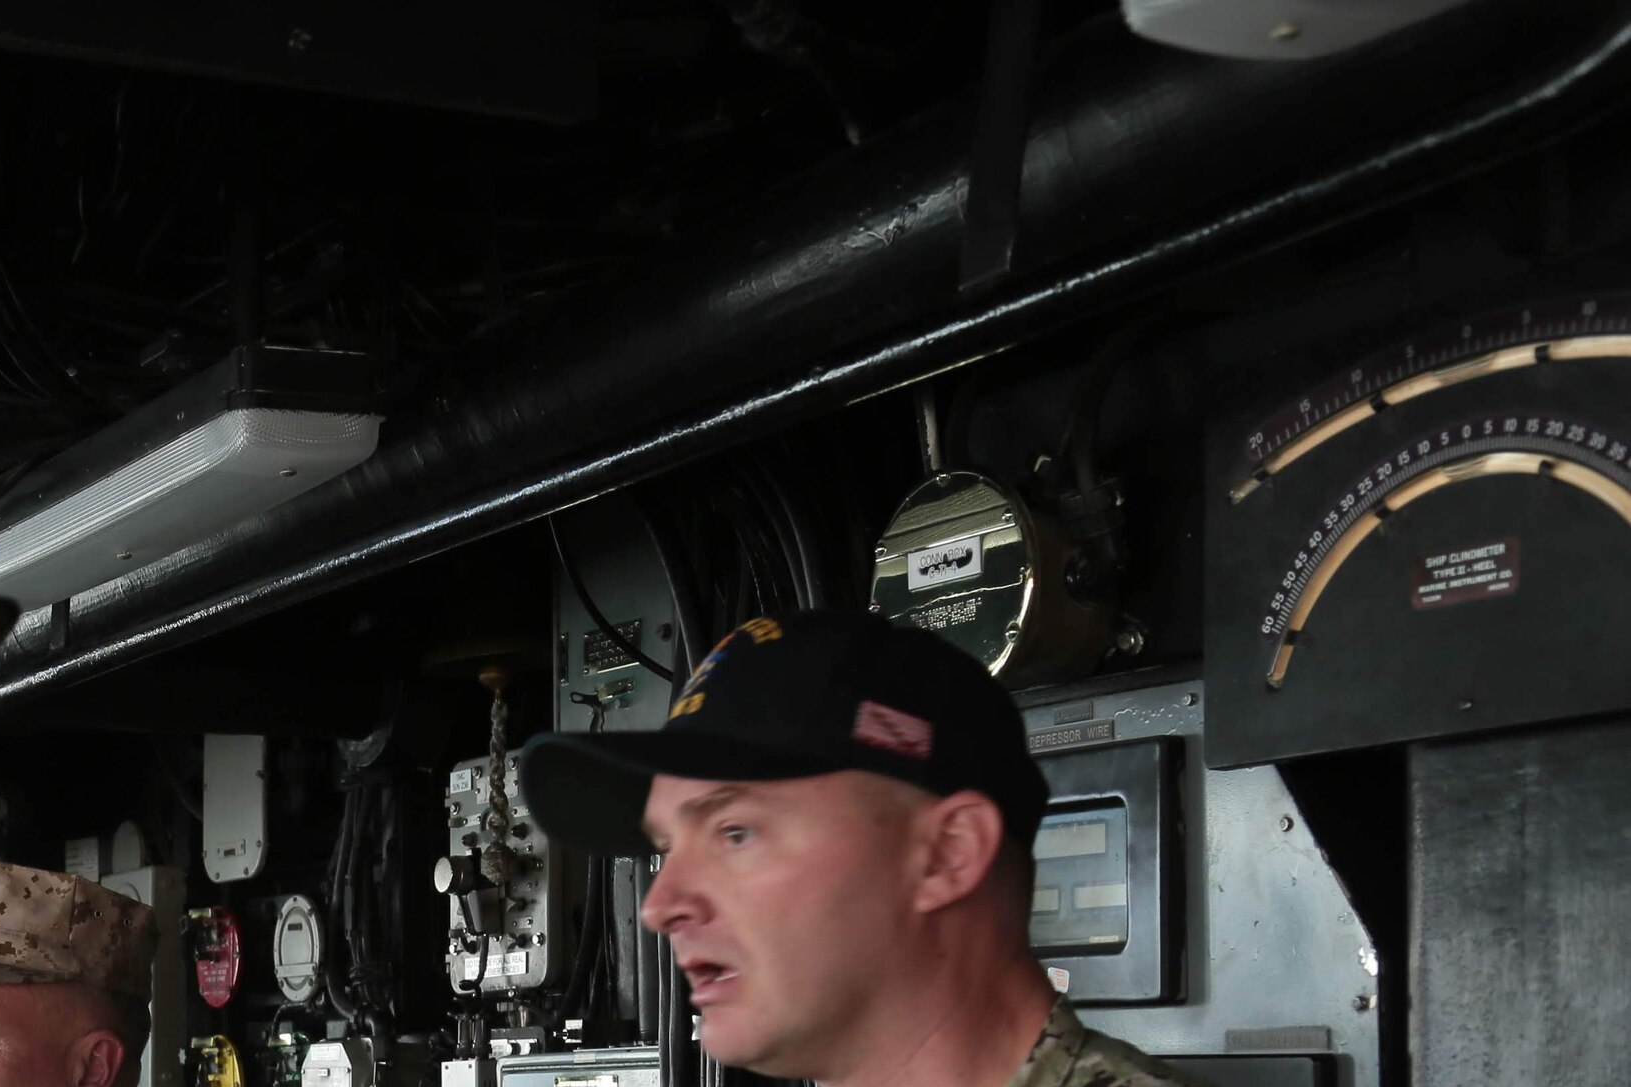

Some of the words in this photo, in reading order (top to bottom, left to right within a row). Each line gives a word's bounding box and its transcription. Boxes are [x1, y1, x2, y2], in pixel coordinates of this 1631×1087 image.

[1249, 432, 1263, 449] 20
[1299, 399, 1310, 413] 15
[1261, 616, 1274, 634] 60
[1271, 592, 1285, 610] 55
[1282, 571, 1296, 589] 50
[1294, 551, 1308, 569] 45
[1308, 531, 1323, 549] 40
[1323, 510, 1339, 529] 35
[1339, 494, 1355, 512] 30
[1357, 476, 1373, 495] 25
[1376, 463, 1392, 480] 20
[1397, 451, 1410, 466] 15
[1417, 440, 1430, 455] 10
[1440, 432, 1449, 445] 5
[1461, 424, 1472, 439] 0
[1484, 420, 1493, 434] 5
[1504, 417, 1517, 432] 10
[1525, 418, 1540, 432] 15
[1544, 421, 1564, 436] 20
[1566, 424, 1586, 442] 25
[1587, 432, 1607, 450] 30
[948, 546, 967, 560] BOX
[1425, 555, 1447, 568] SHIP
[1029, 729, 1082, 748] DEPRESSOR
[1086, 725, 1110, 739] WIRE
